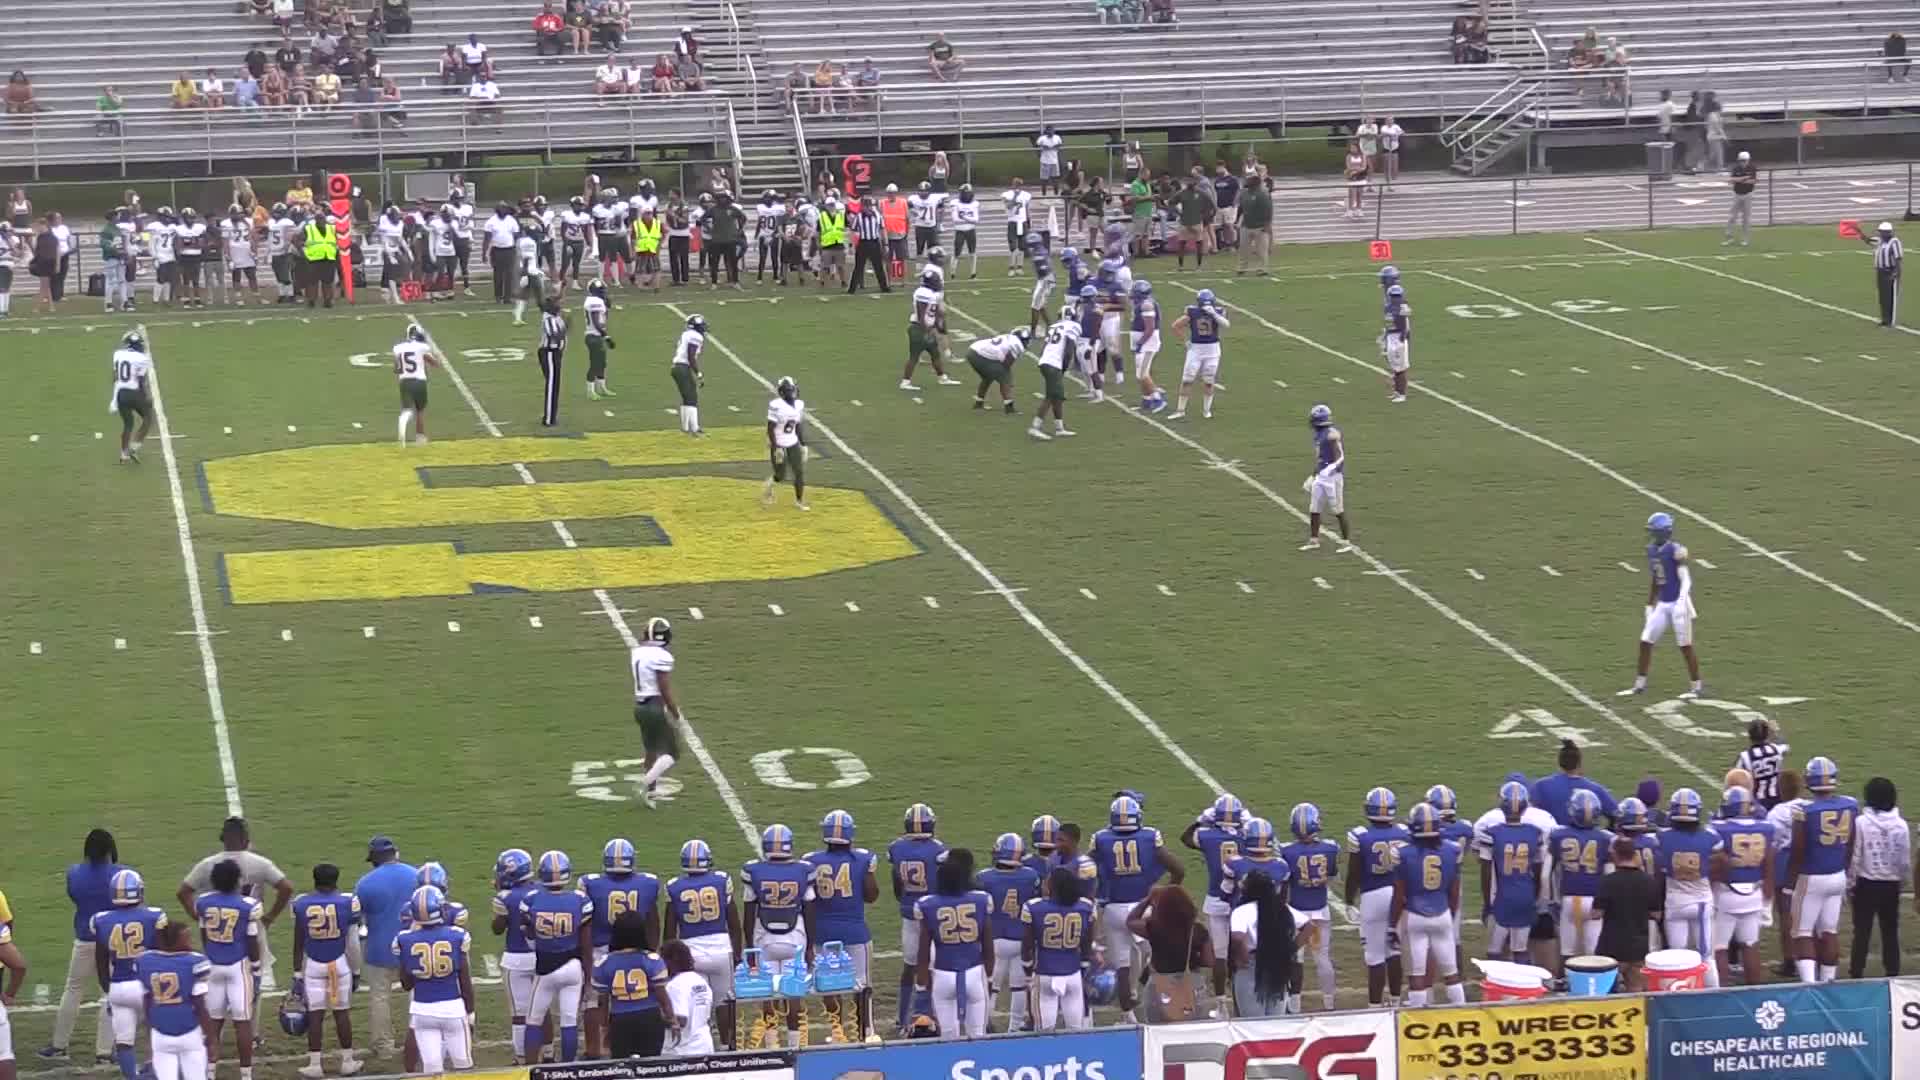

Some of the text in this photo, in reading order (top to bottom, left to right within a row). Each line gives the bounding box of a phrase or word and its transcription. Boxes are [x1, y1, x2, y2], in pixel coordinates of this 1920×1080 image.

[920, 206, 934, 221] 71
[114, 360, 131, 383] 10
[397, 351, 418, 374] 15
[633, 659, 641, 692] 1
[1818, 810, 1852, 846] 54
[1111, 839, 1143, 875] 11
[1296, 853, 1329, 888] 13
[1423, 854, 1442, 891] 6
[1559, 837, 1599, 874] 24
[815, 861, 854, 899] 64
[305, 903, 341, 941] 21
[607, 890, 640, 925] 61
[681, 886, 720, 924] 39
[108, 921, 145, 960] 42
[203, 906, 241, 944] 27
[935, 903, 980, 945] 25
[1041, 911, 1083, 950] 20
[410, 940, 454, 979] 36
[1403, 1020, 1481, 1041] CAR
[1669, 1031, 1869, 1057] CHESAPEAKE REGIONAL
[951, 1056, 1106, 1080] Sports
[1438, 1033, 1636, 1068] 333-3333
[1713, 1051, 1827, 1073] HEALTHCARE
[636, 1066, 667, 1075] Sports
